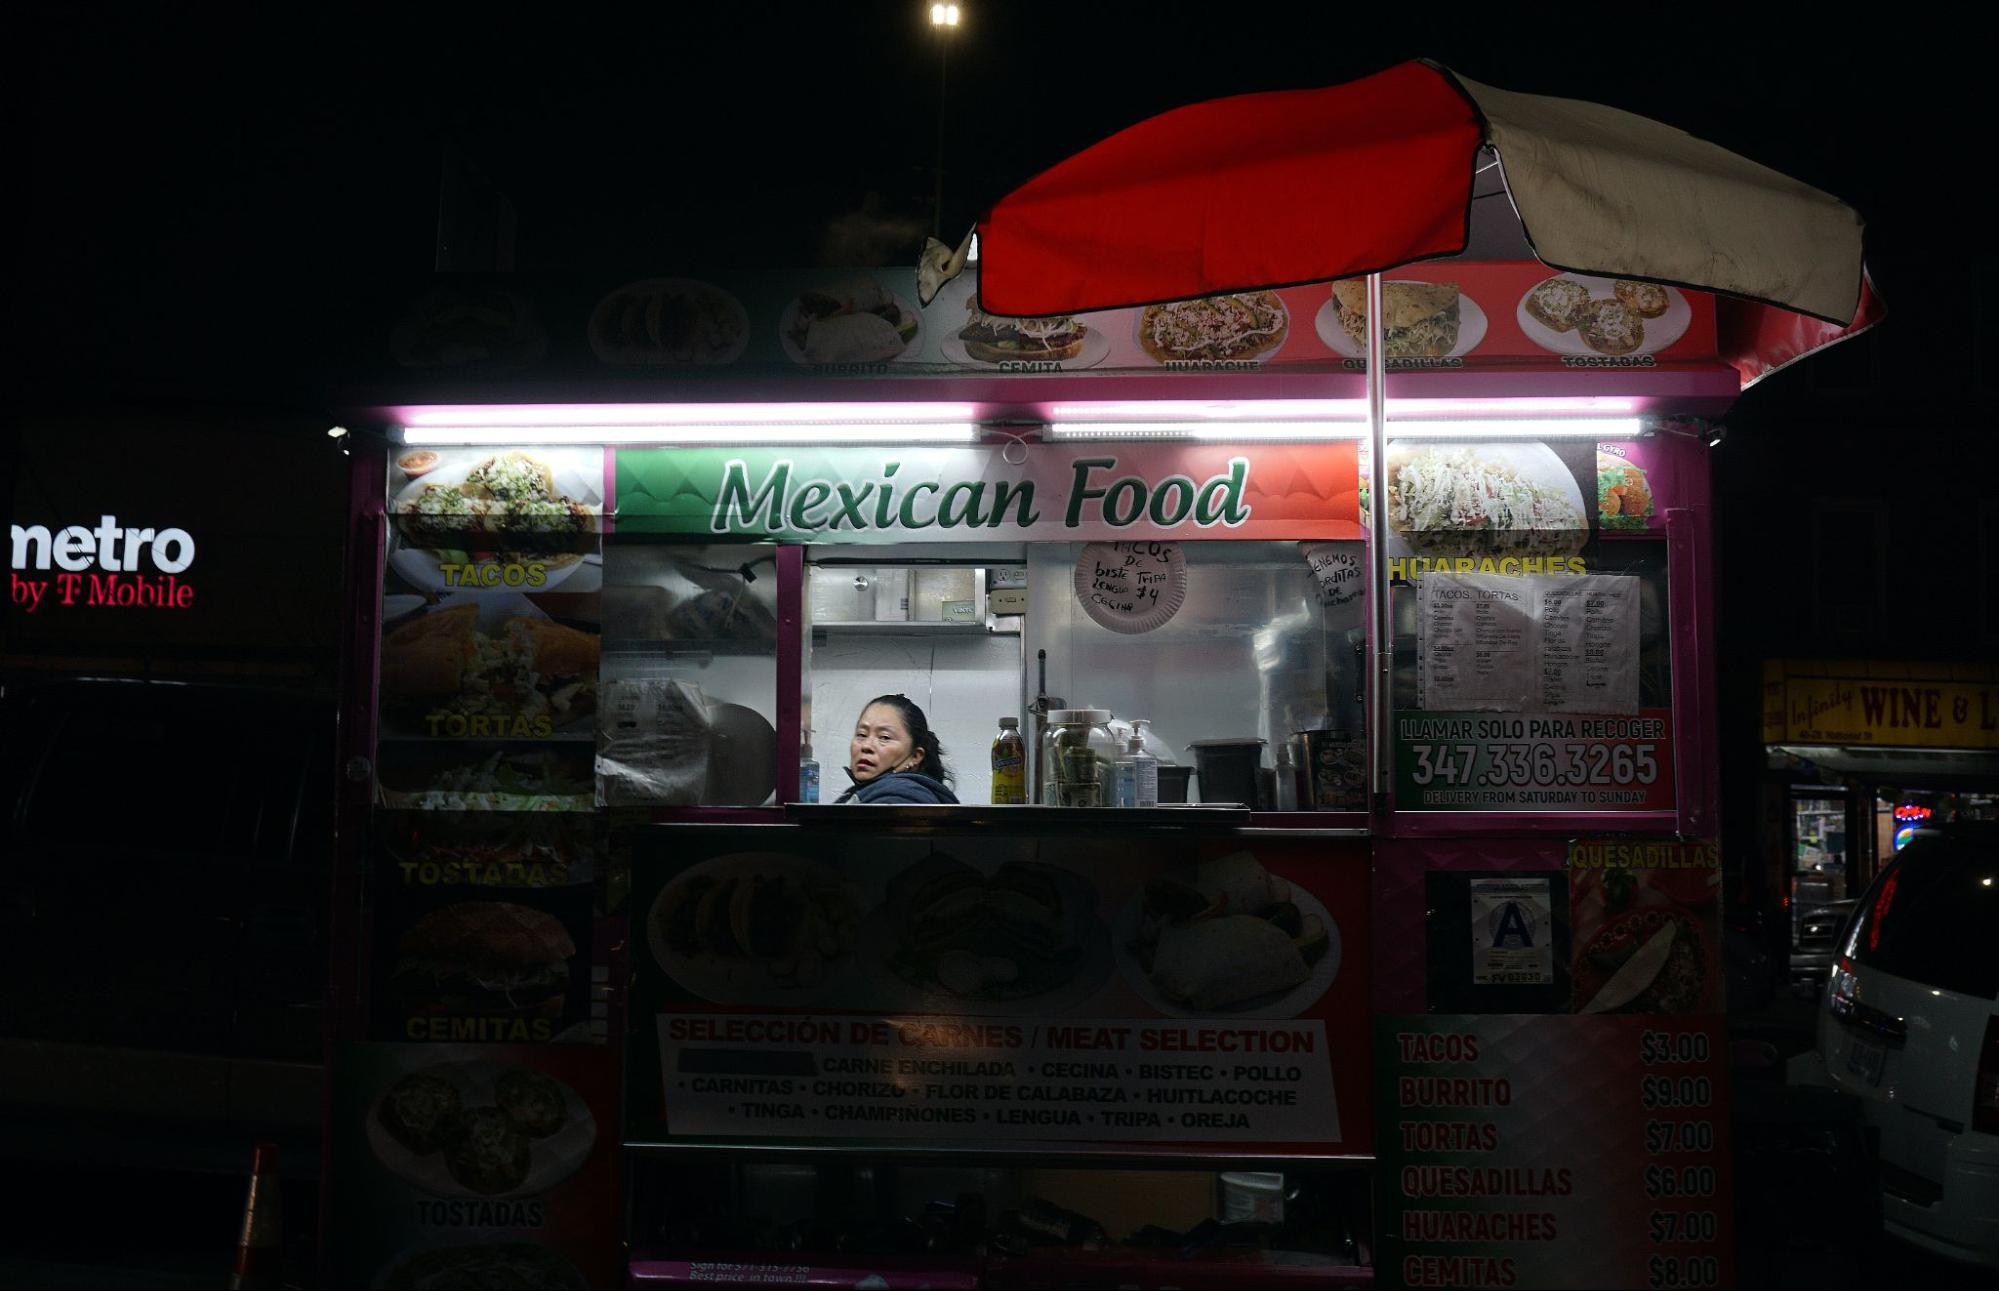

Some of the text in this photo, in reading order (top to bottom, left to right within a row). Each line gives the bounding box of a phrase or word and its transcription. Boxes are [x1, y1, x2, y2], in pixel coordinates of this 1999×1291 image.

[999, 361, 1063, 374] CEMITA
[1164, 359, 1259, 372] HUARACHE
[1343, 357, 1462, 370] QUSADILLAS
[1562, 355, 1656, 368] TOSTADAS
[714, 457, 1252, 533] Mexican Food
[441, 562, 546, 588] TACOS
[1389, 556, 1588, 582] HUARACHES
[10, 573, 49, 615] by
[1860, 686, 1942, 729] WINE
[1953, 694, 1969, 724] &
[425, 713, 552, 739] TORTAS
[1402, 719, 1666, 740] LLAMAR SOLO PARA RECOGER
[1412, 743, 1658, 787] 347.336.3265
[1424, 790, 1647, 804] DELIVERY FROM SATURDAY TO SUNDAY
[1572, 842, 1720, 870] QUESADILLAS
[399, 861, 569, 887] TOSTADAS
[1493, 903, 1533, 947] A
[407, 1015, 553, 1043] CEMITAS
[668, 1015, 845, 1046] SELECCIÓN
[850, 1021, 887, 1046] DE
[898, 1022, 1023, 1051] CARNES
[1047, 1026, 1132, 1051] MEAT
[1139, 1028, 1315, 1054] SELECTION
[1399, 1032, 1710, 1064] TACOS $3.00
[823, 1057, 1301, 1083] CARNE ENCHILADA CECINA BISTEC POLLO
[691, 1077, 1298, 1106] CARNITAS CHORIZO FLOR DE CALABAZA HUITLACOCHE
[1400, 1077, 1711, 1108] BURRITO $9.00
[742, 1101, 1251, 1131] TINGA CHAMPIÑONES LENGUA TRIPA OREJA
[1401, 1121, 1713, 1153] TORTAS $7.00
[1402, 1166, 1715, 1198] QUESADILLAS $6.00
[418, 1201, 543, 1227] TOSTADAS
[1403, 1210, 1717, 1242] HUARACHES $7.00
[1404, 1256, 1719, 1288] CEMITAS $8.00
